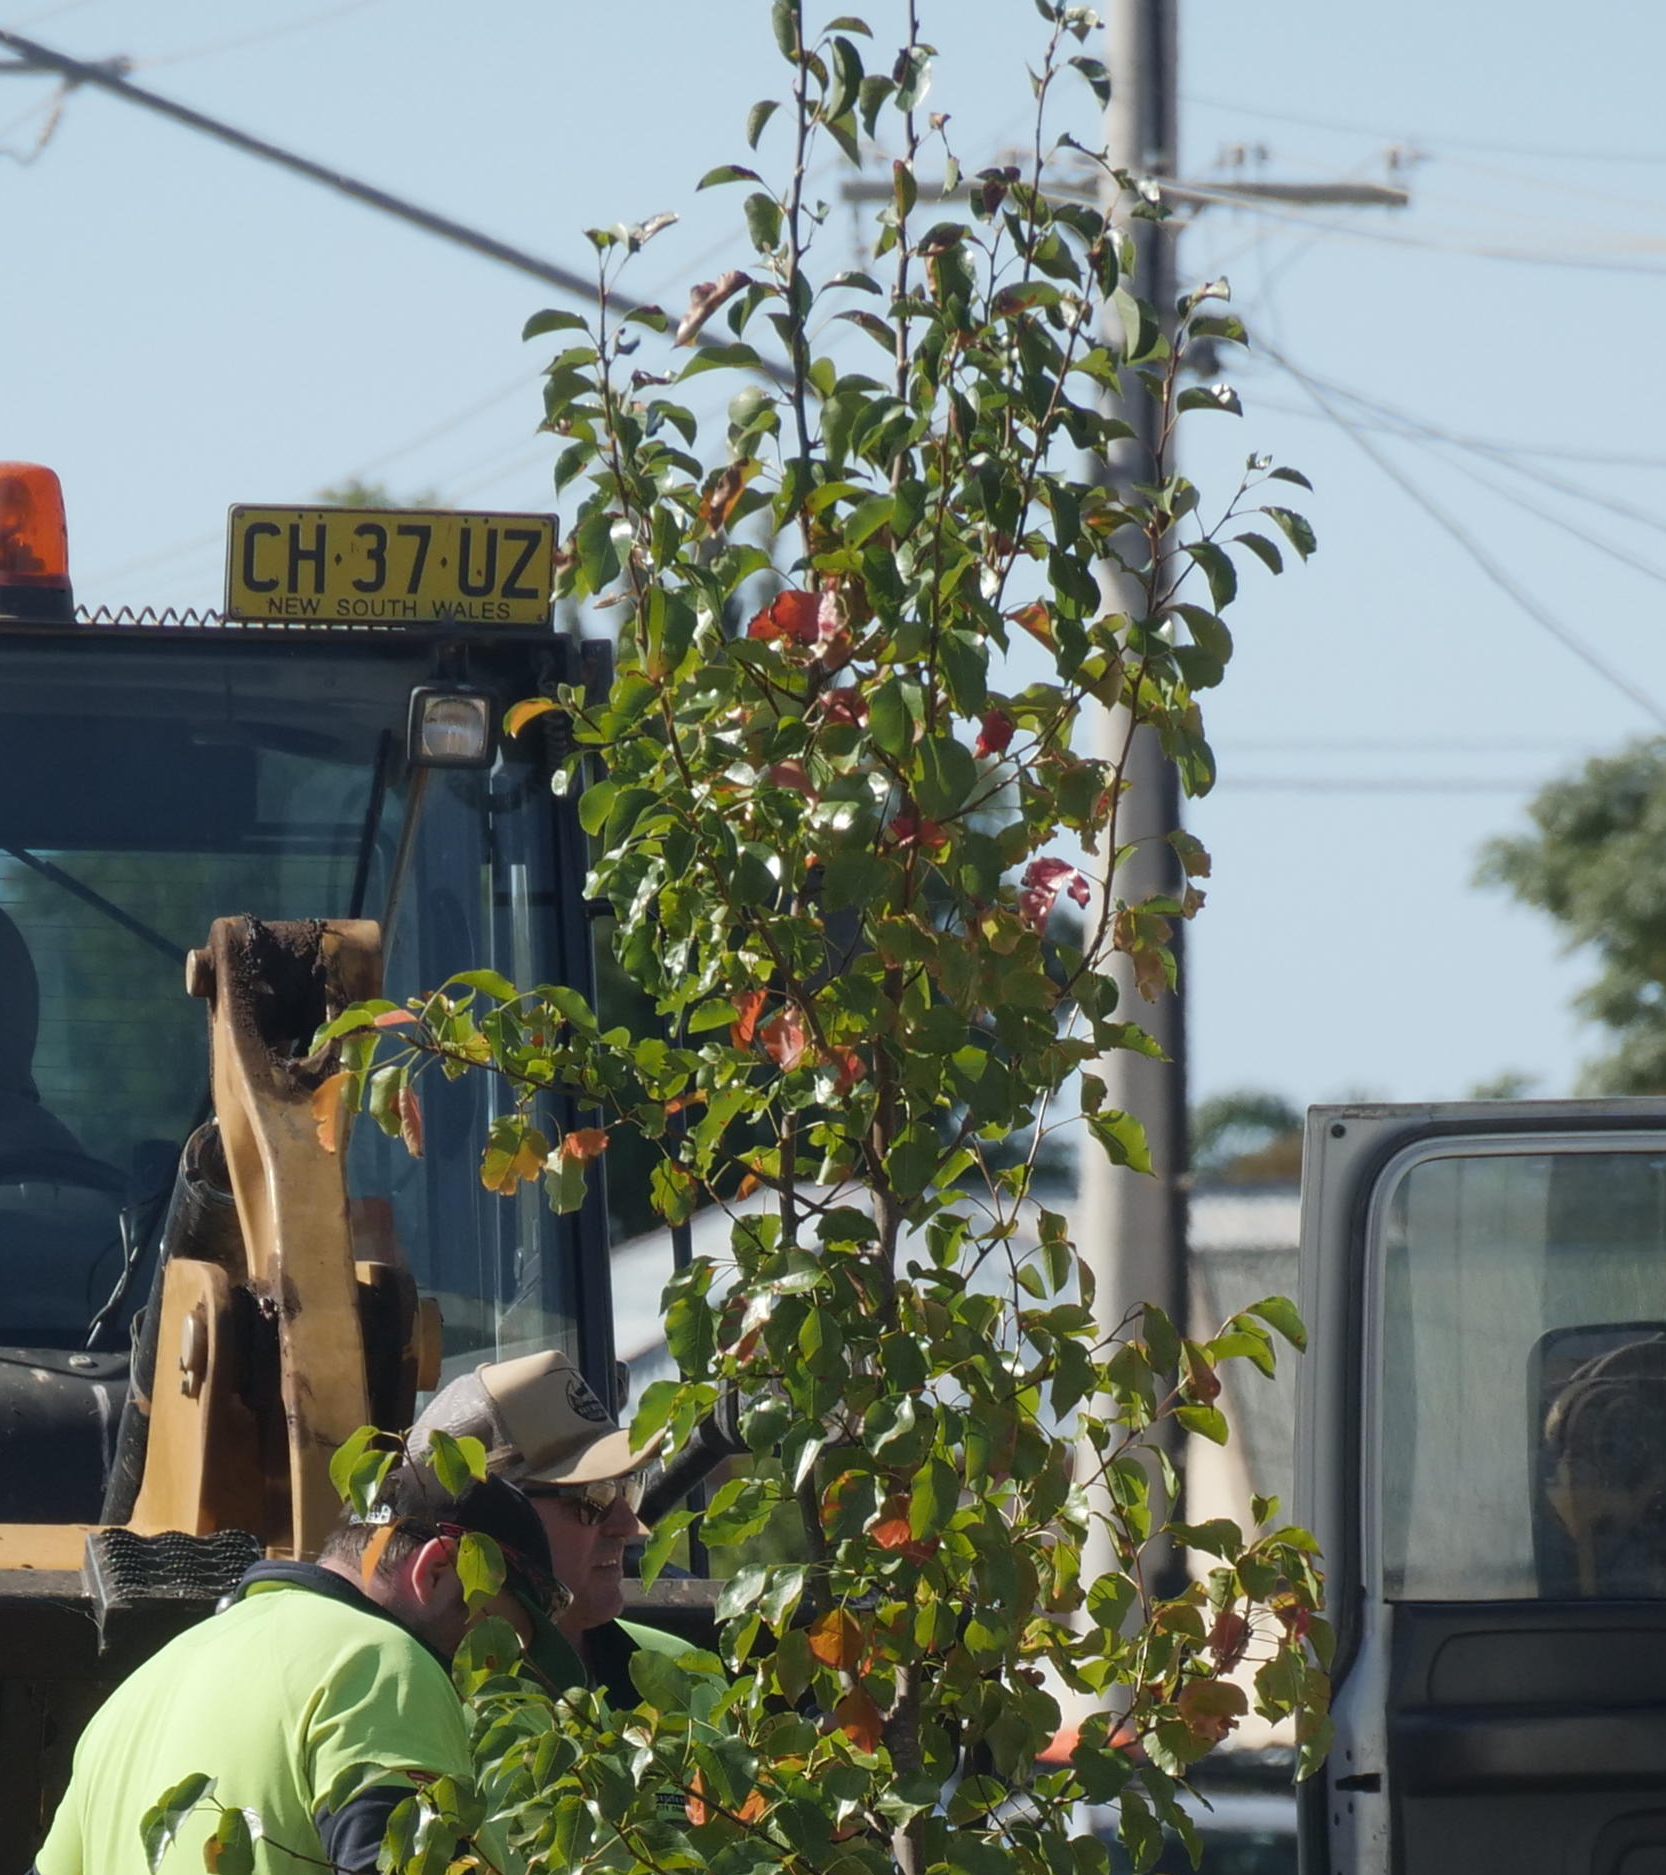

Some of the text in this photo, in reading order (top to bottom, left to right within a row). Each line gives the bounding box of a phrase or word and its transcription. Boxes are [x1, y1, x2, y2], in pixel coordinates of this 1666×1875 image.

[268, 597, 511, 620] NEW SOUTH WALES
